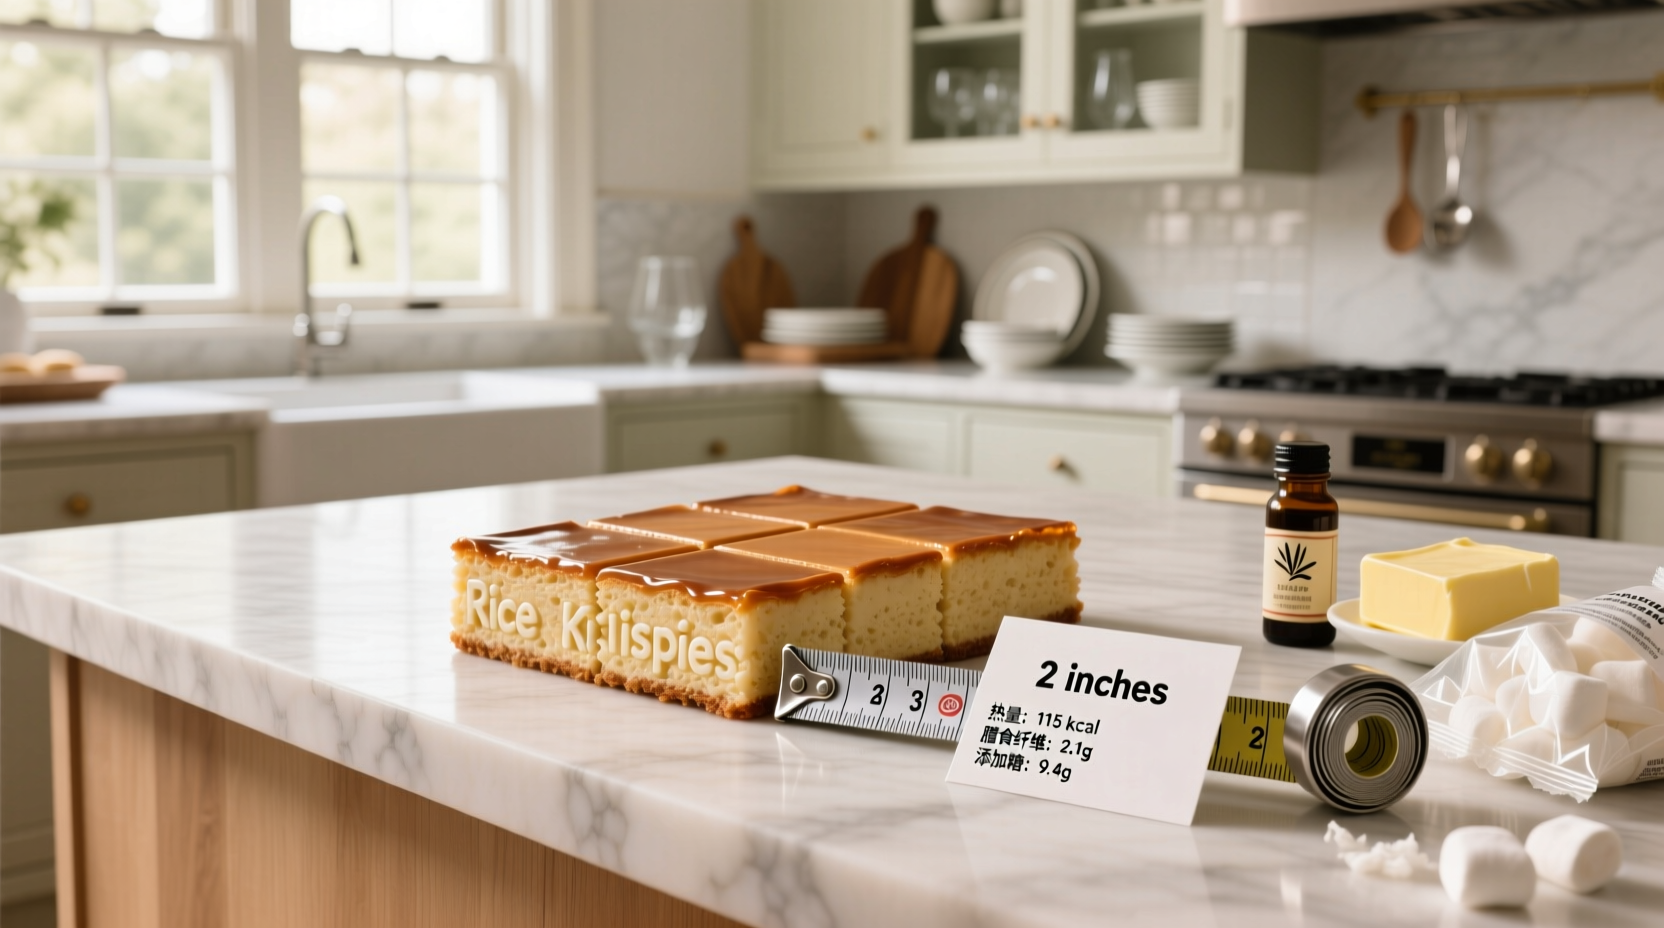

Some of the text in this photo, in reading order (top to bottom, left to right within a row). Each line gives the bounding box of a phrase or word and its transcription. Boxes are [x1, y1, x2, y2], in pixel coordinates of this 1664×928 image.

[466, 579, 540, 639] Rice
[1035, 659, 1169, 706] 2 inches
[909, 689, 925, 712] 3
[1037, 711, 1063, 729] 115
[1065, 715, 1101, 735] kcal
[1248, 726, 1265, 750] 2
[1059, 739, 1094, 763] 2.1g
[1038, 758, 1072, 783] 9.4g
